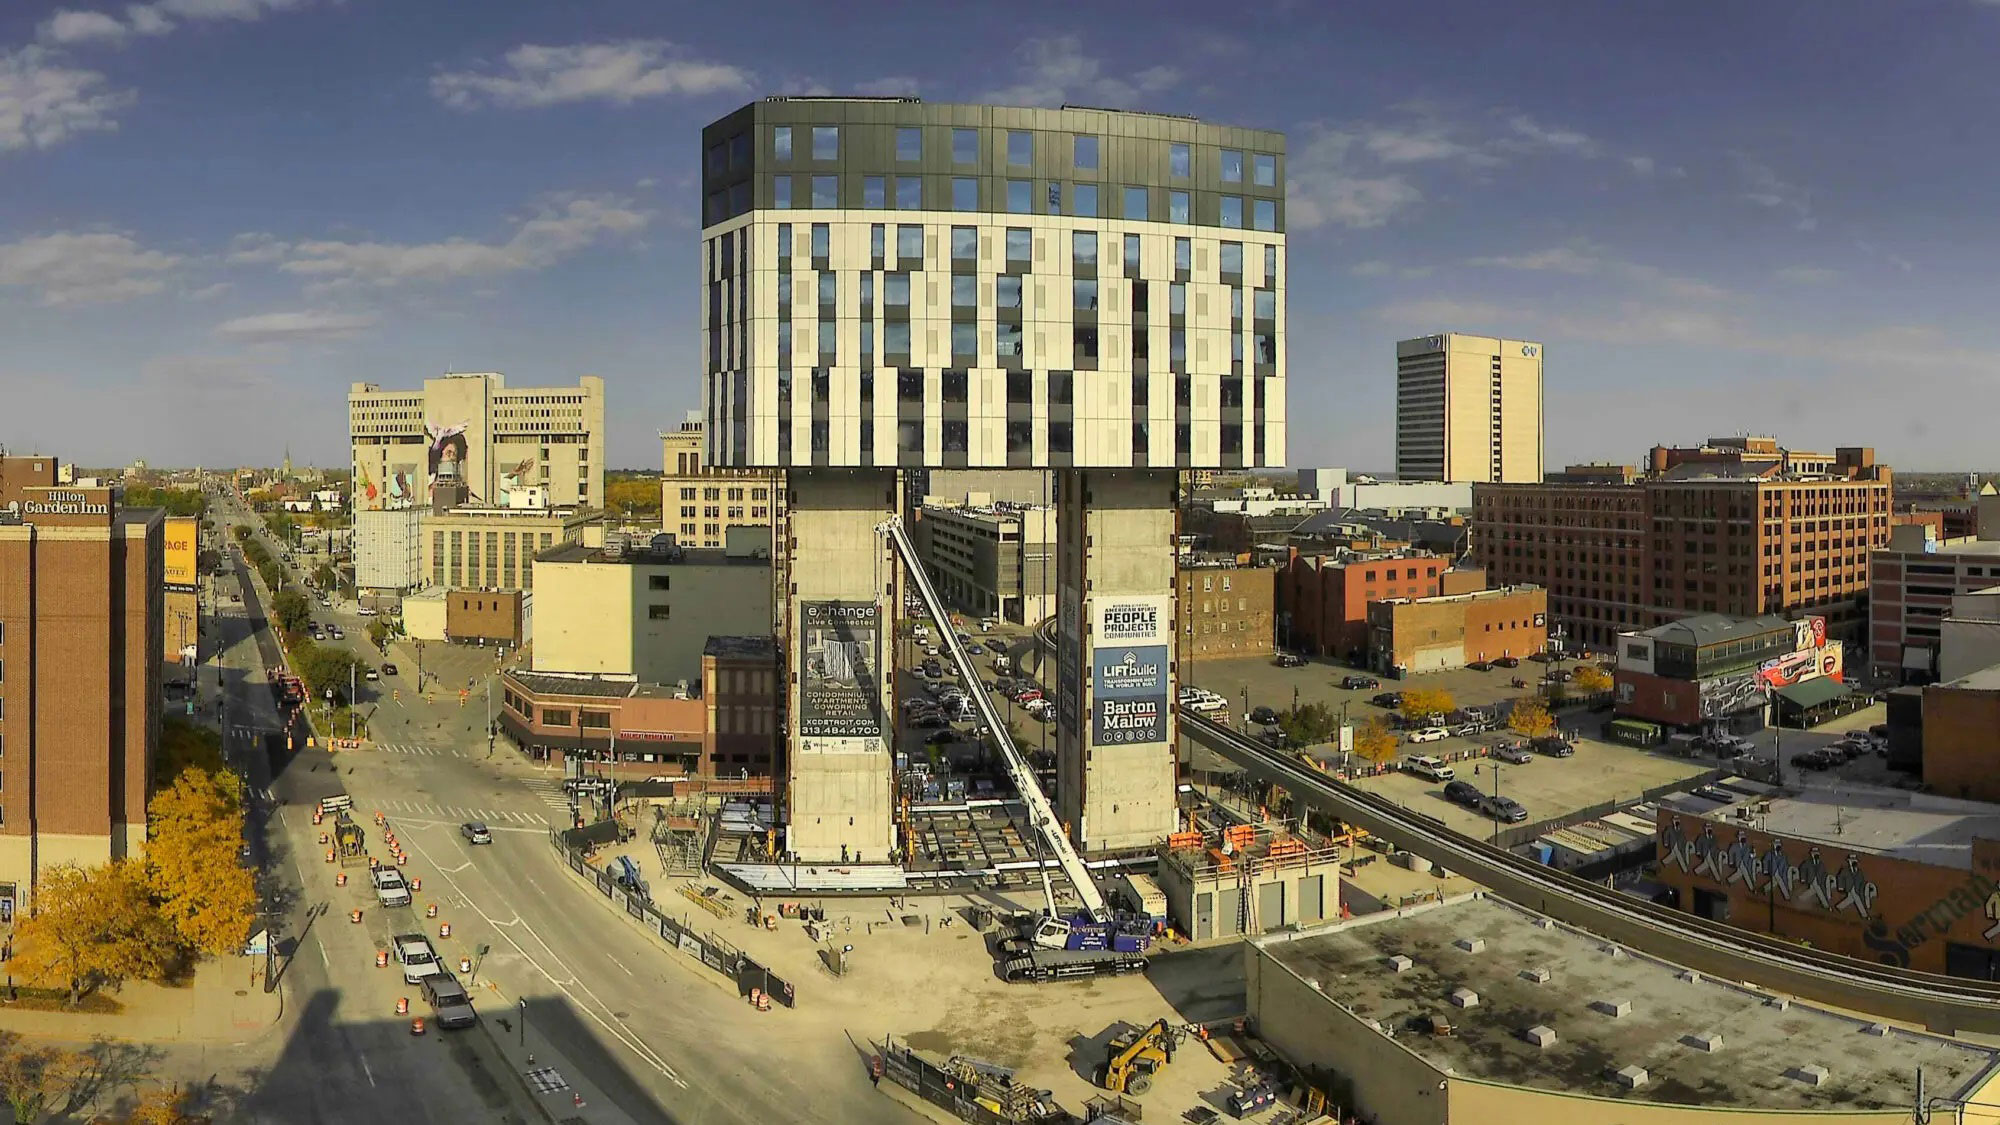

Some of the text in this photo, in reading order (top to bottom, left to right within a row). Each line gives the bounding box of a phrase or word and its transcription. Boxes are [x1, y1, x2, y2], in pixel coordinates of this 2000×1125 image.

[48, 491, 86, 501] Hilton
[24, 501, 108, 514] Garden Inn
[1105, 612, 1156, 623] PEOPLE
[1104, 622, 1157, 632] PROJECTS
[1104, 631, 1157, 639] COMMUNITIES
[1103, 700, 1157, 715] Barton
[1103, 714, 1157, 730] Malow
[802, 727, 880, 735] 313.484.4700
